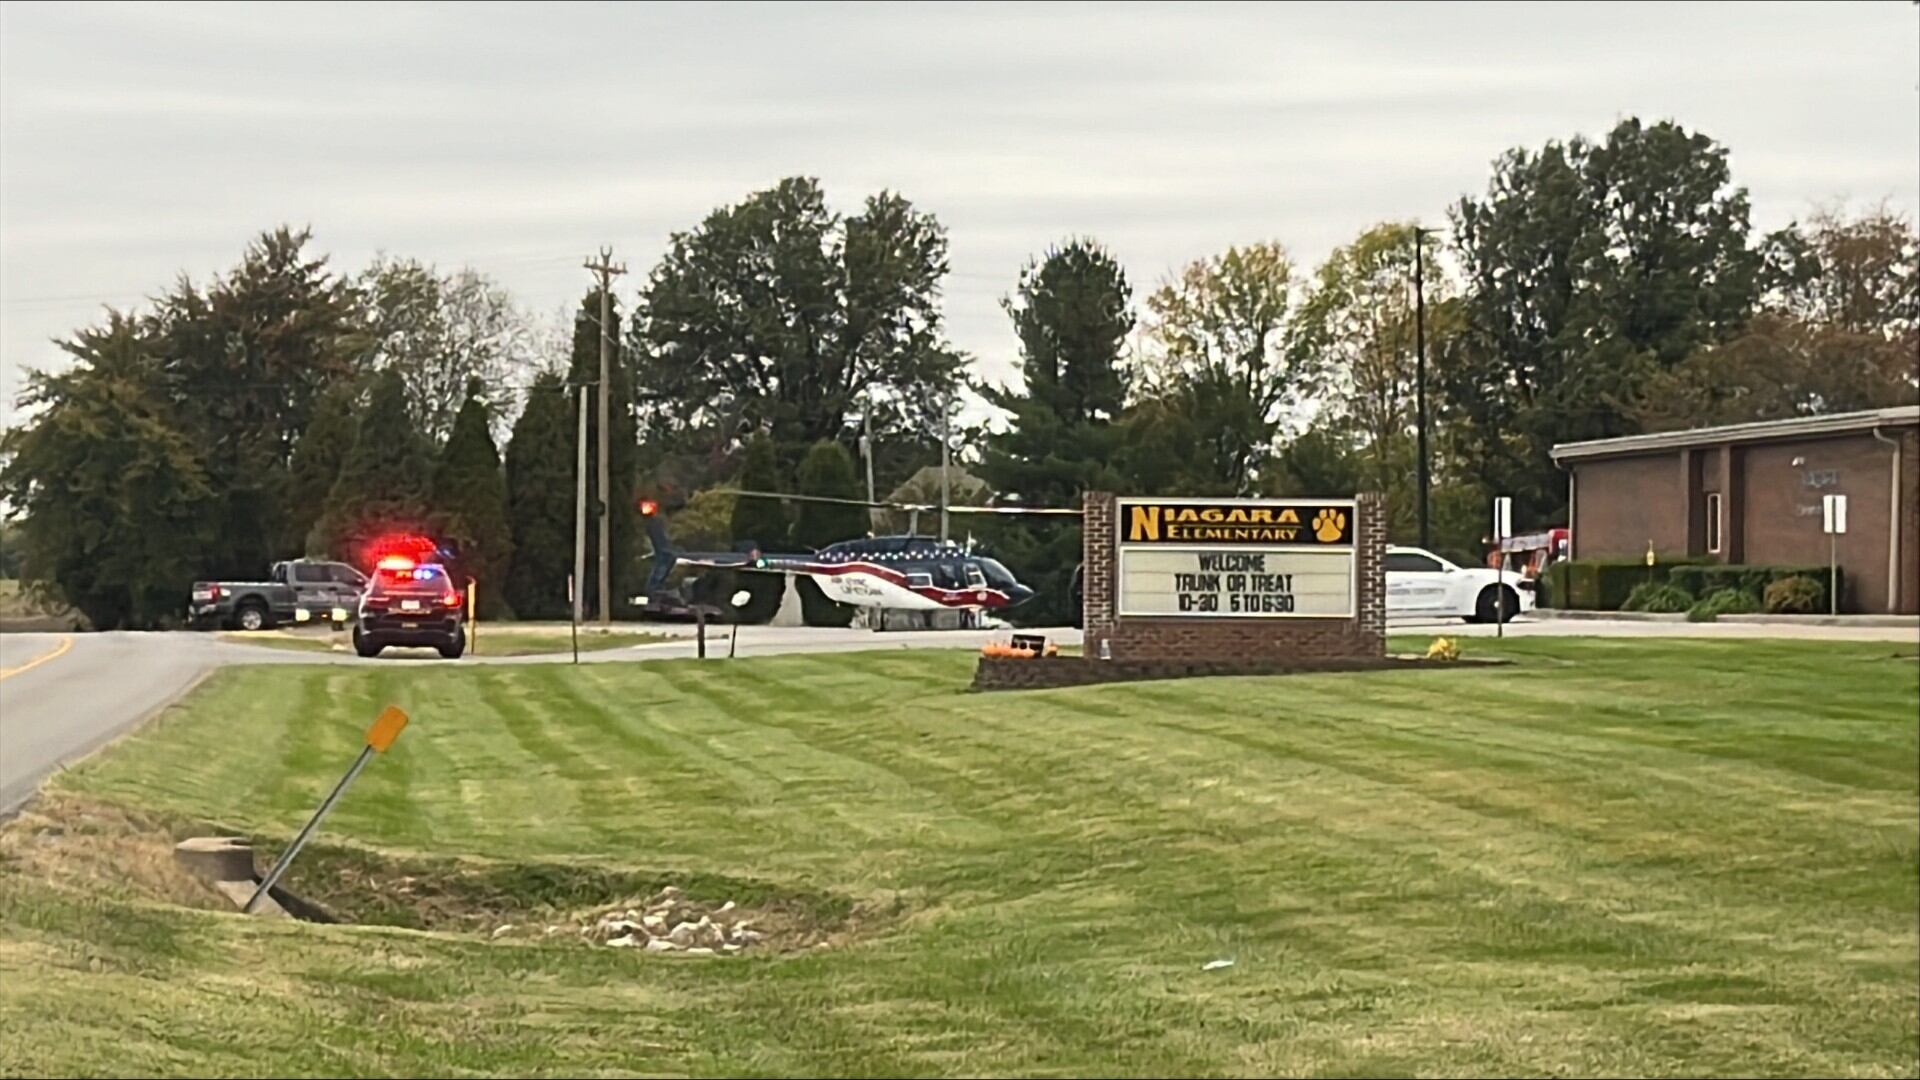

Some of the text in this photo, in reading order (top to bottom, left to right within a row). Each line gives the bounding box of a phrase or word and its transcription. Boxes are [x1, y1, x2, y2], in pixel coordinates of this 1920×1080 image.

[1130, 506, 1299, 540] NIAGARA
[1167, 525, 1297, 540] ELEMENTARY
[1198, 554, 1265, 572] WELCOME
[1174, 574, 1293, 592] TRUNK OR TREAT
[1230, 593, 1240, 612] 5
[1243, 594, 1260, 612] TO
